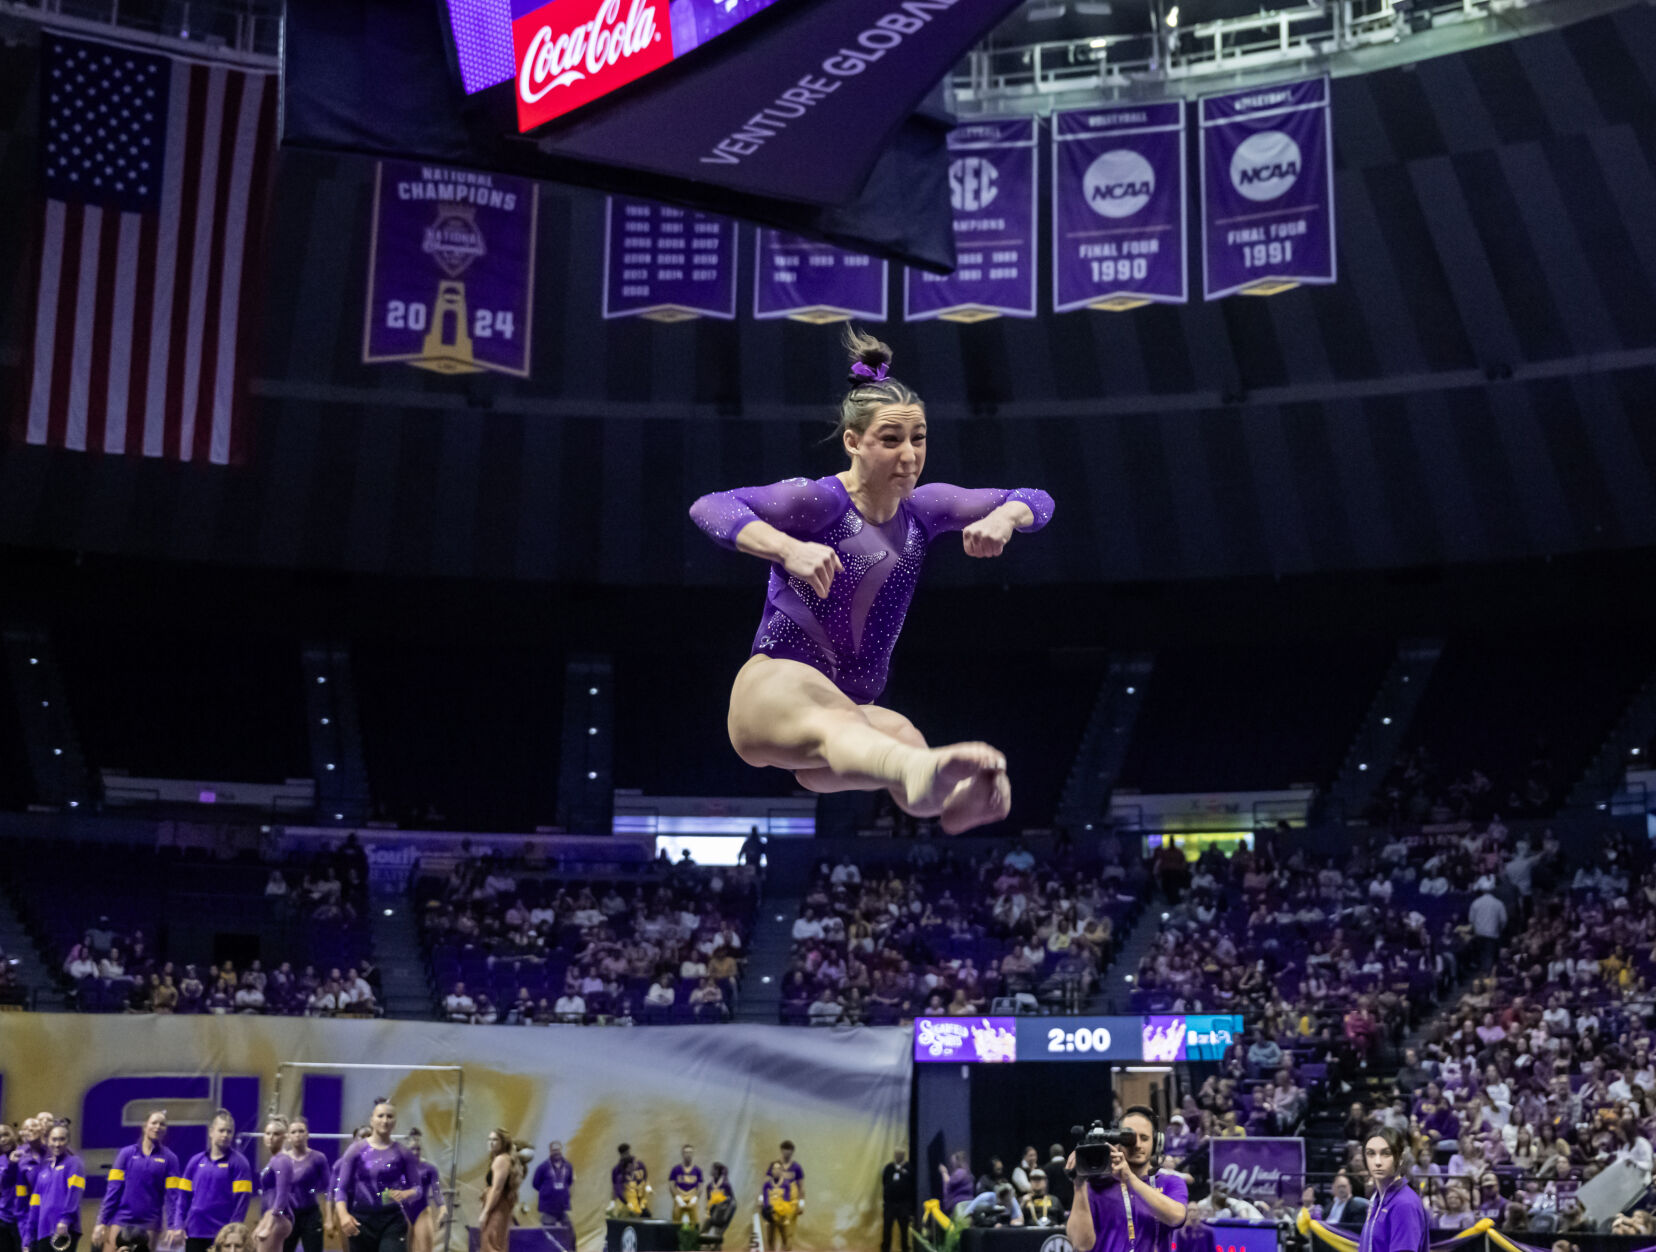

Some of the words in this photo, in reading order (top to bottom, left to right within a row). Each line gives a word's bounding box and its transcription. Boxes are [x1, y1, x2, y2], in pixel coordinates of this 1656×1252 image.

[519, 0, 657, 104] Coca-Cola
[700, 74, 842, 164] VENTURE
[421, 167, 493, 188] NATIONAL
[948, 157, 999, 211] SEC
[1239, 161, 1297, 186] NCAA
[398, 181, 517, 212] CHAMPIONS
[1092, 180, 1151, 202] NCAA
[1227, 226, 1266, 246] FINAL
[1270, 219, 1307, 239] FOUR
[1078, 242, 1118, 259] FINAL
[1121, 238, 1160, 256] FOUR
[1242, 239, 1293, 269] 1991
[1090, 257, 1147, 283] 1990
[1047, 1027, 1111, 1053] 2:00
[0, 1072, 346, 1200] SU
